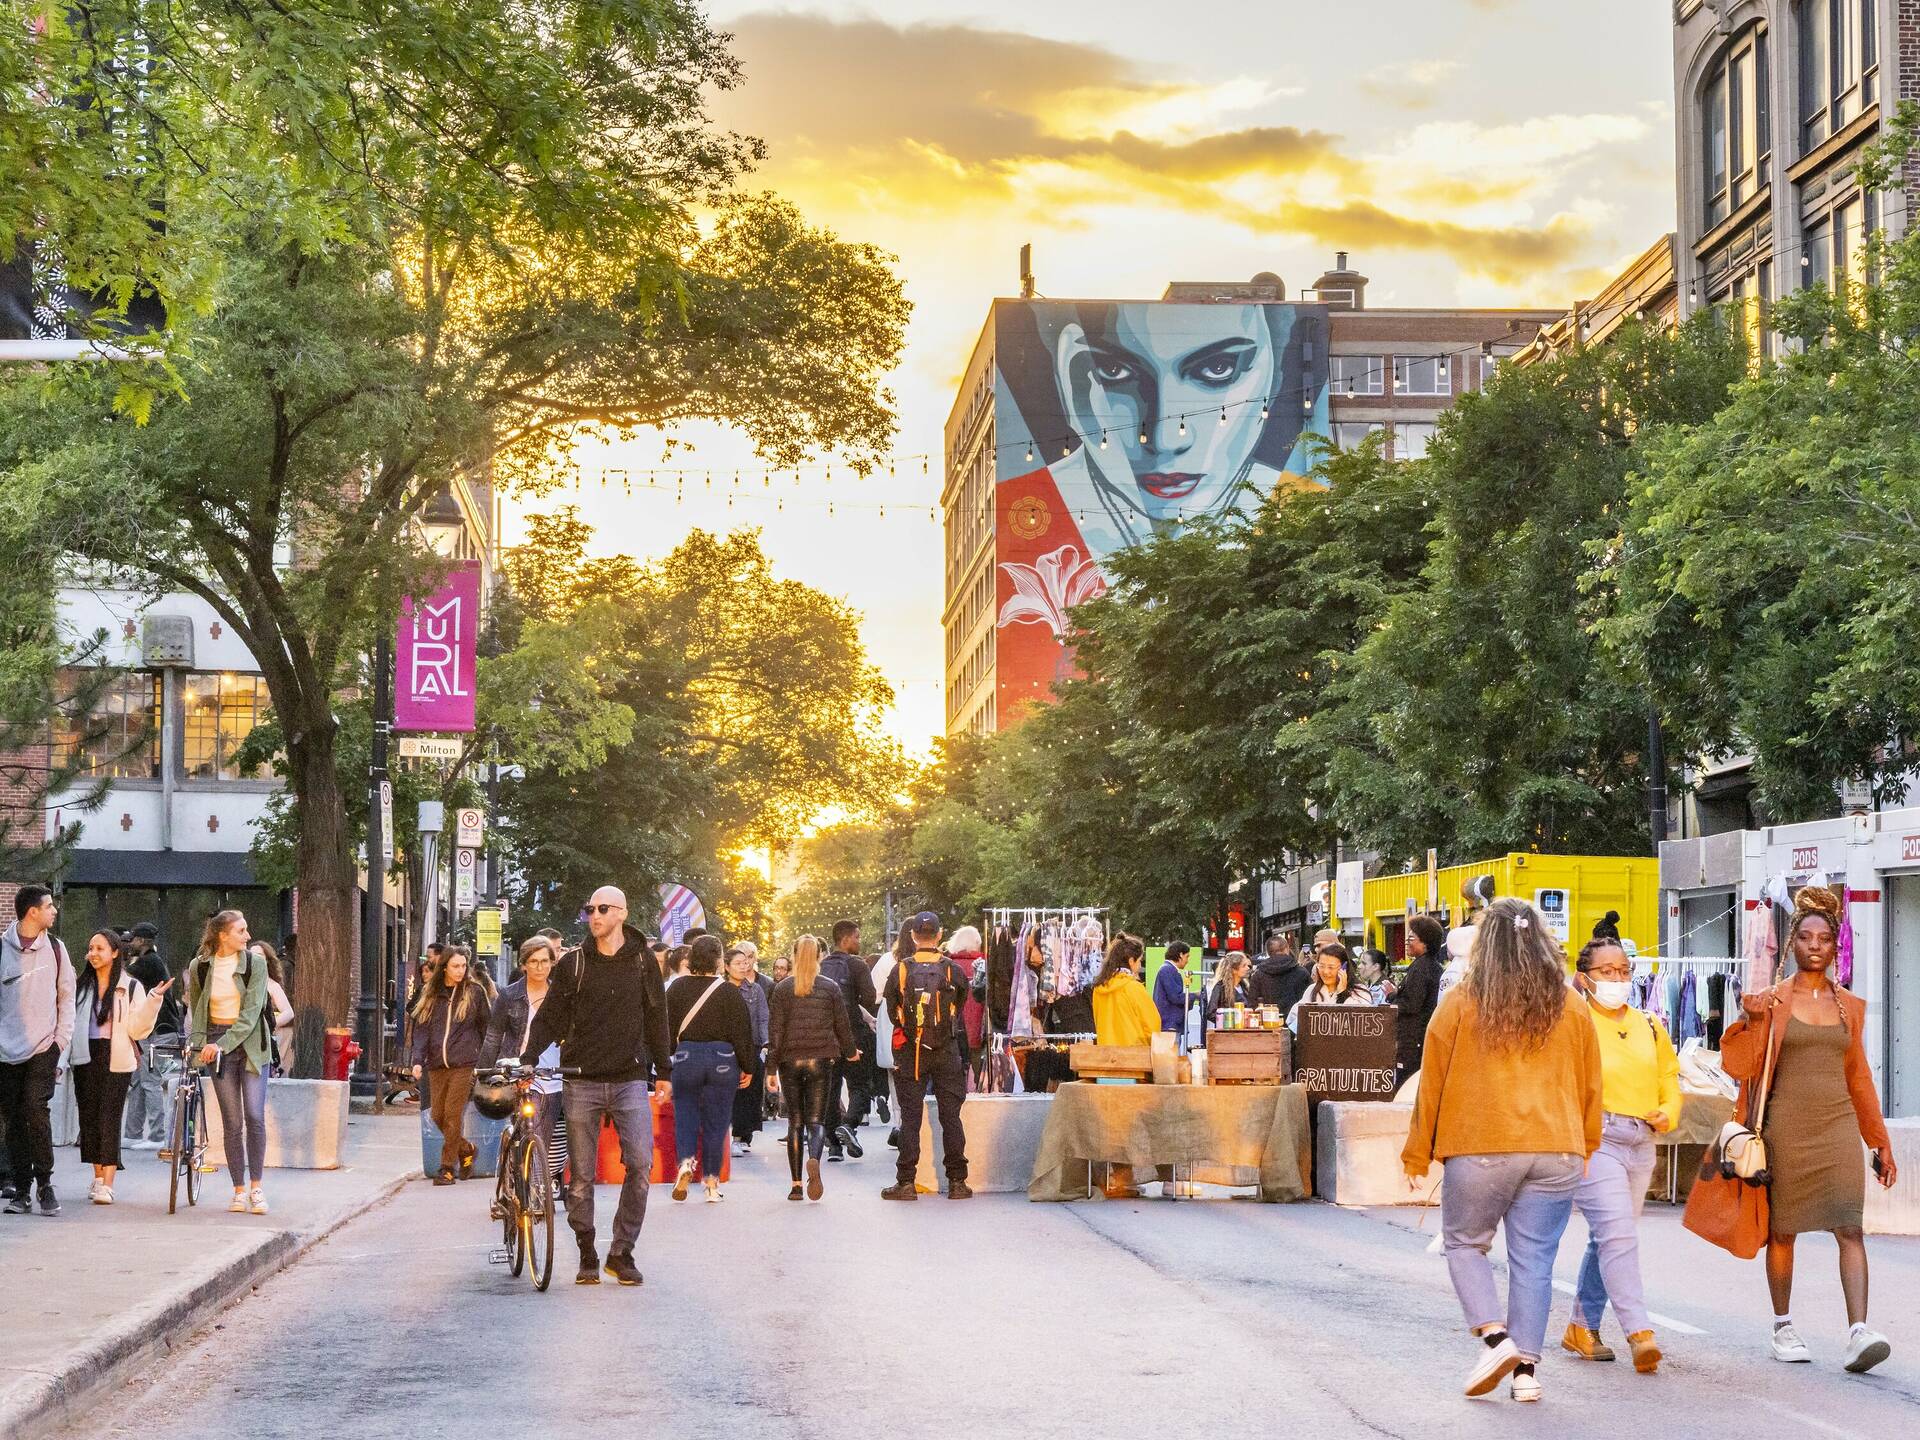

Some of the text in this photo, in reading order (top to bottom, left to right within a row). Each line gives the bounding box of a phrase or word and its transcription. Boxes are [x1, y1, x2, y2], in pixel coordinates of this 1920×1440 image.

[420, 745, 456, 755] Milton
[1793, 849, 1817, 868] PODS
[1308, 1011, 1384, 1036] TOMATES
[1295, 1067, 1394, 1093] GRATUITES
